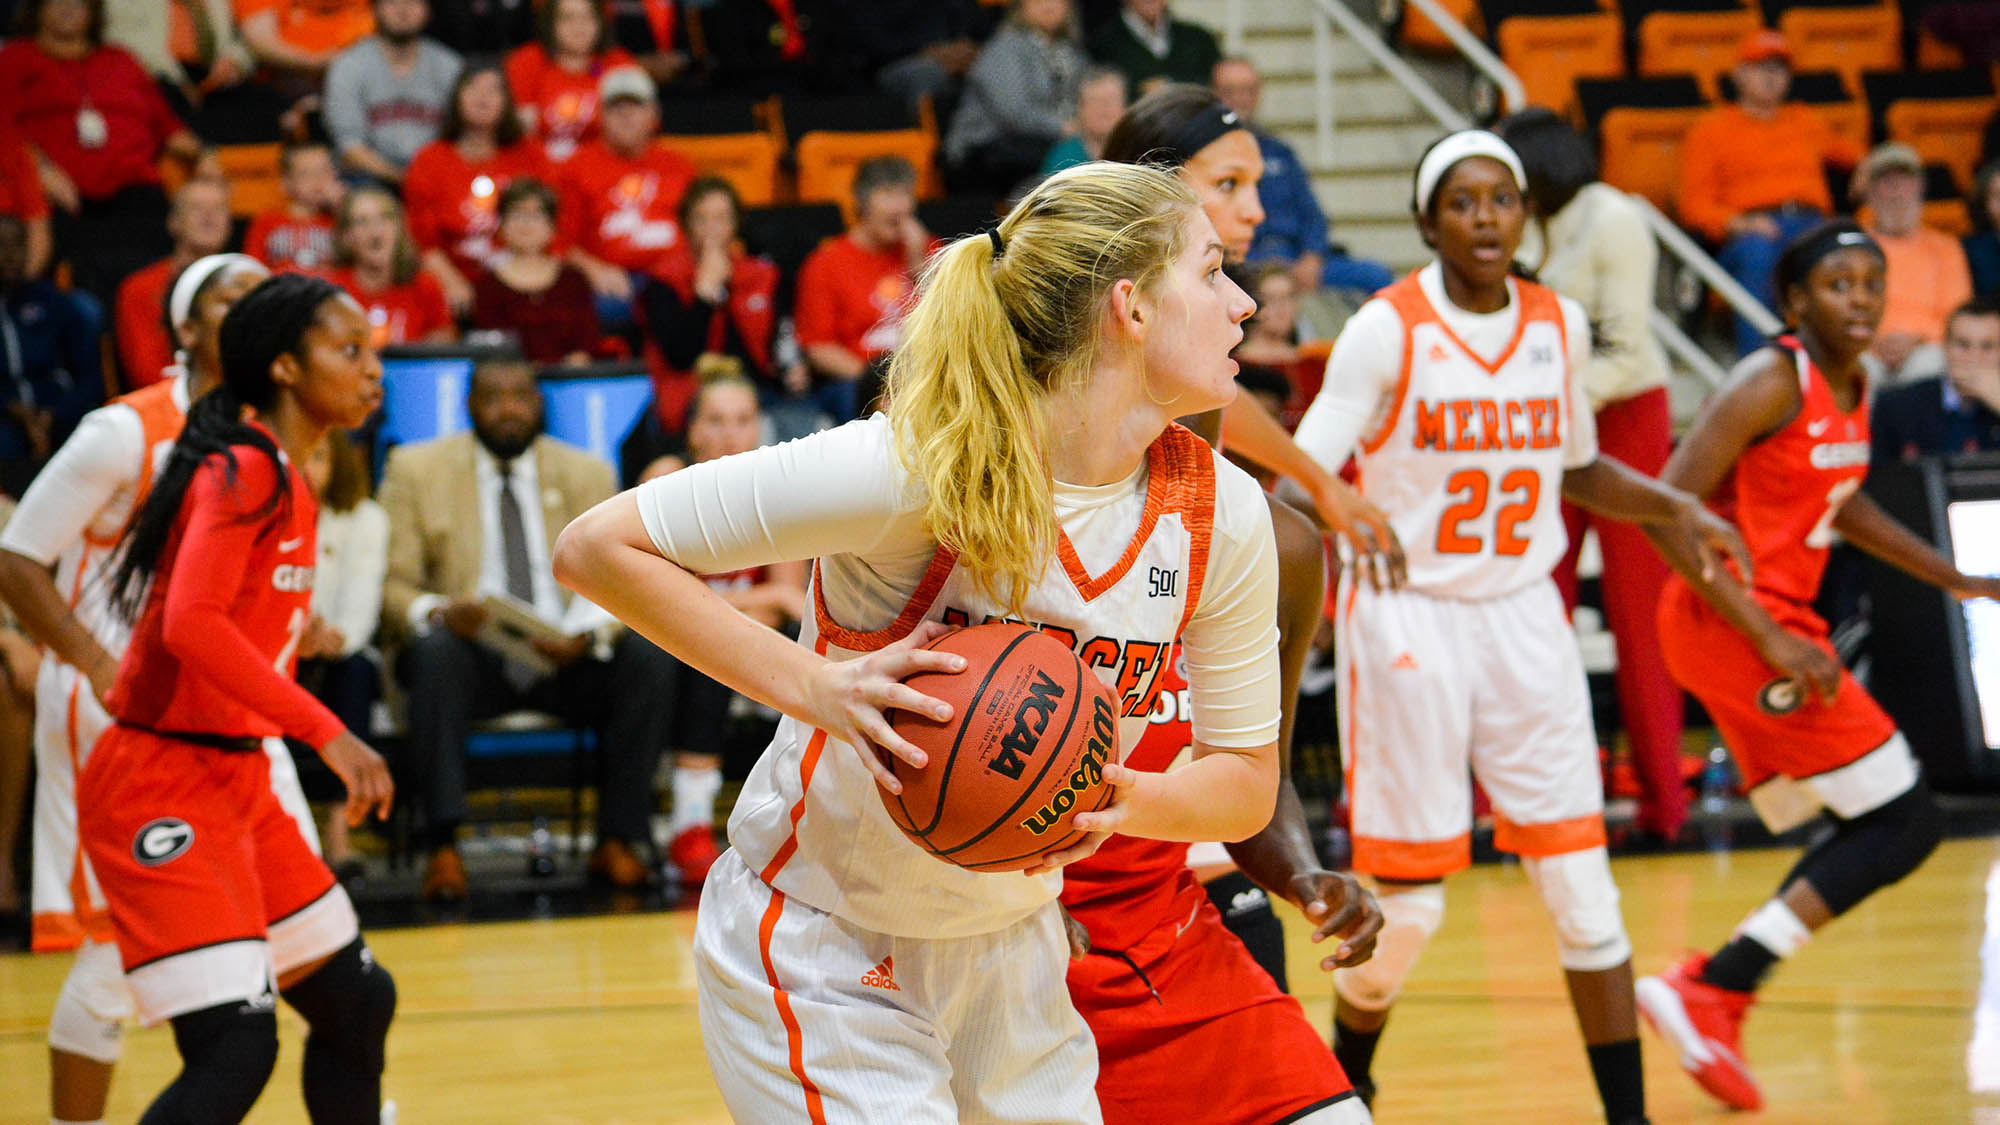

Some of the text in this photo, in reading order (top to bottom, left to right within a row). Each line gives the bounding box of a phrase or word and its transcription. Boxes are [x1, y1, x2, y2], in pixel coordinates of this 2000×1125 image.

[1436, 468, 1541, 556] 22
[987, 669, 1065, 781] NCAA
[1020, 695, 1114, 836] Wilson
[860, 975, 901, 991] adid
